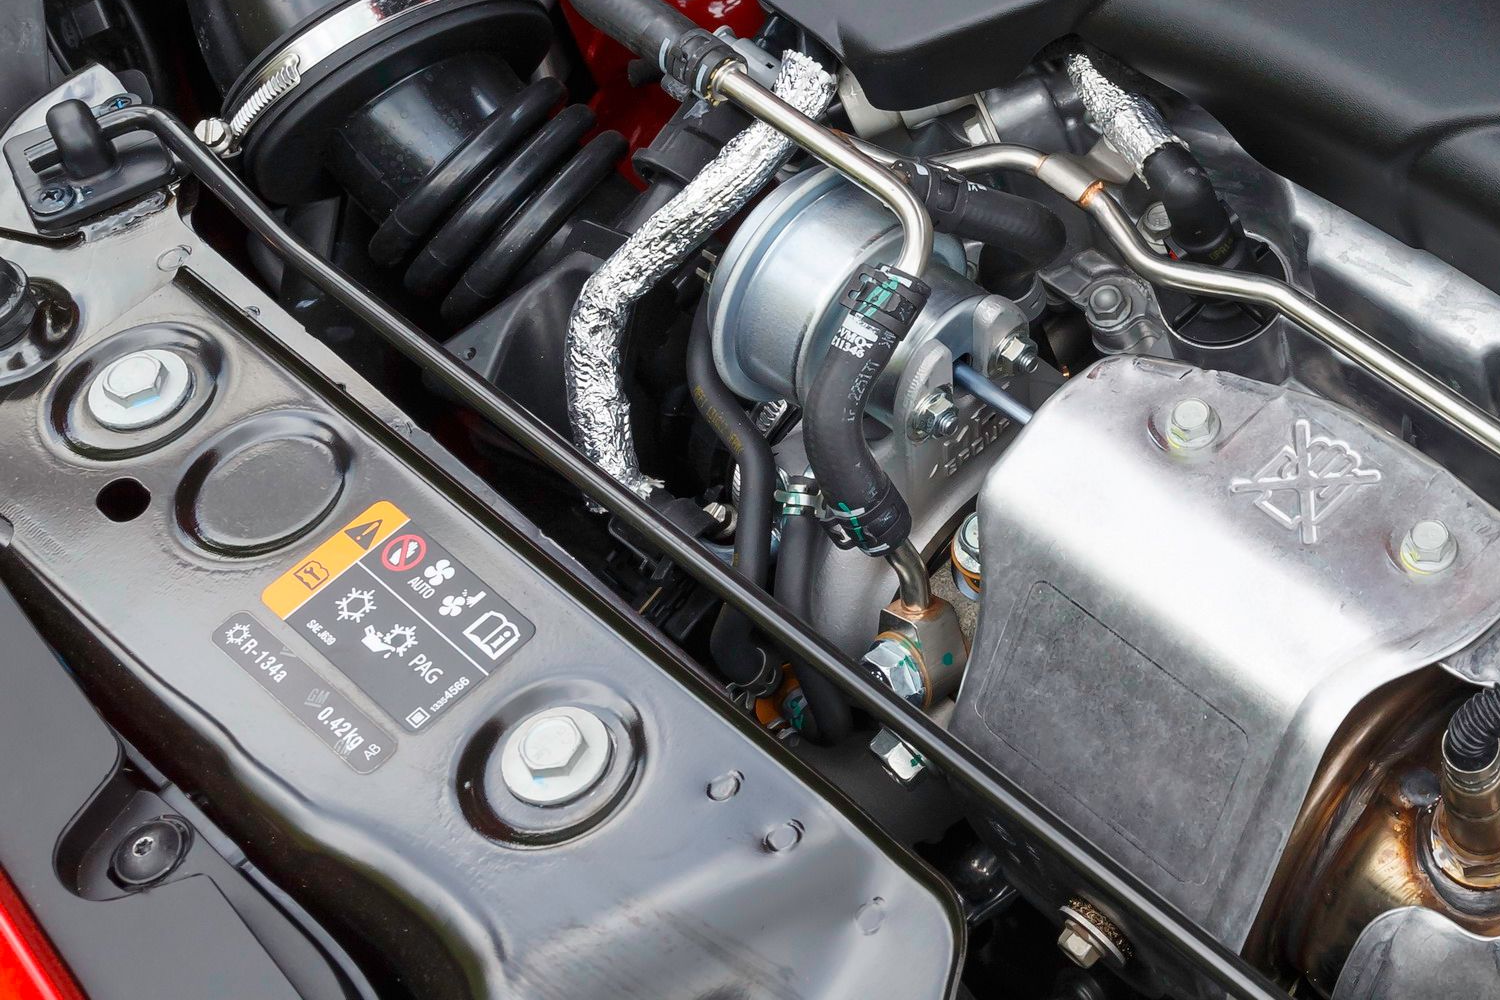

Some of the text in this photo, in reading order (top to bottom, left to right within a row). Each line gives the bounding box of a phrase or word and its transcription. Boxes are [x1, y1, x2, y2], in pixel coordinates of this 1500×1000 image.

[407, 576, 436, 600] AUTO
[306, 619, 323, 634] SAE
[240, 638, 288, 684] R-134a
[407, 653, 444, 686] PAG
[430, 676, 470, 713] 13354566
[363, 743, 382, 761] AB
